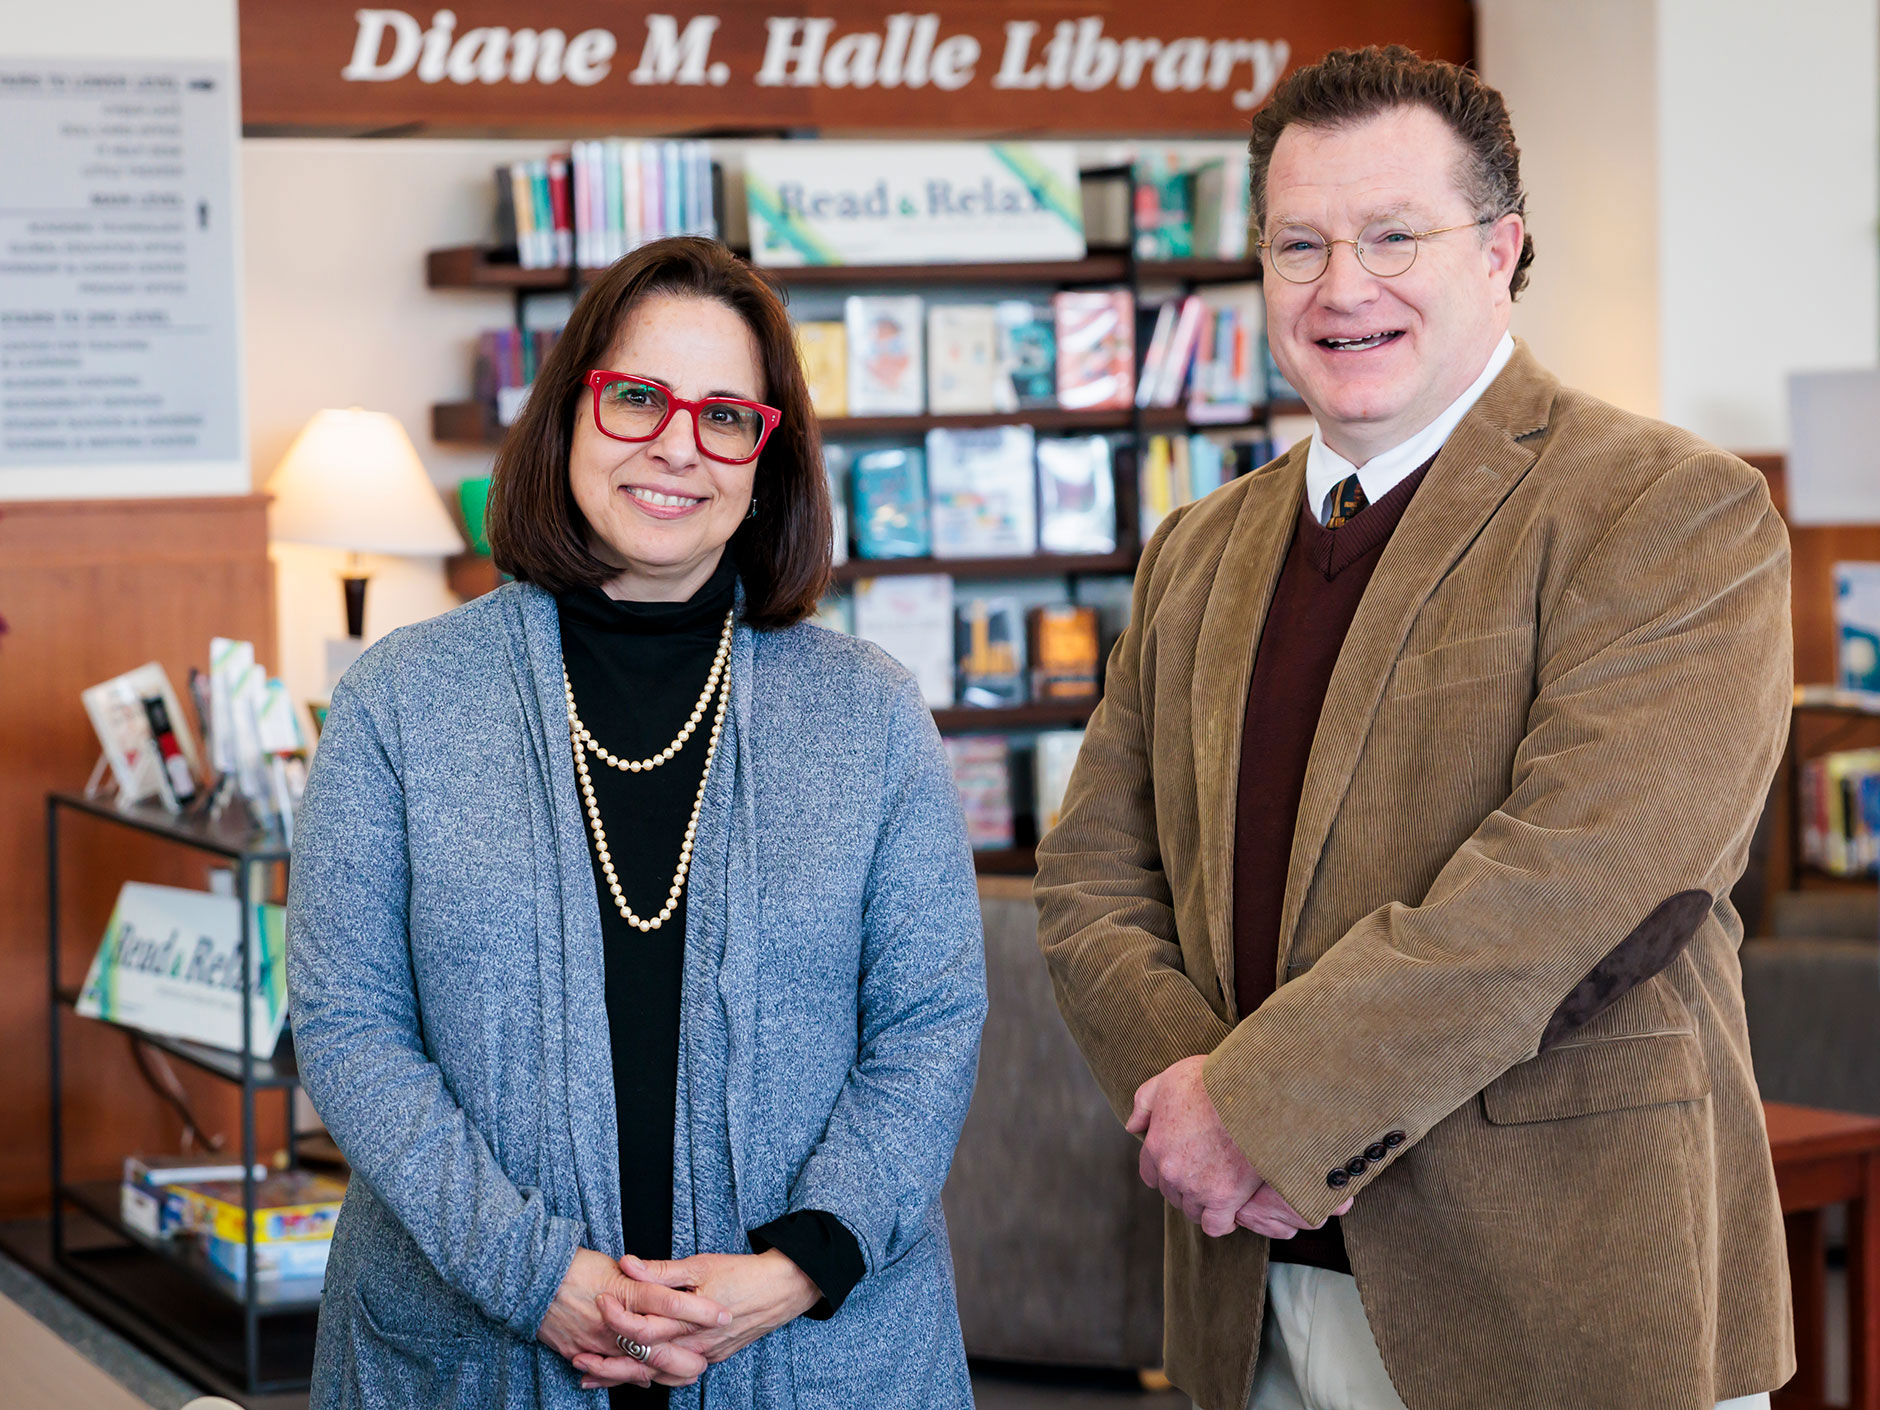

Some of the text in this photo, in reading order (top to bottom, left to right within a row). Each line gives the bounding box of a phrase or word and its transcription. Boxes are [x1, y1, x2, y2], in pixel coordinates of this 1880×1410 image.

[340, 8, 1291, 111] Diane M. Halle Library
[778, 177, 889, 220] Read
[925, 175, 1050, 218] Relax
[108, 923, 180, 976] Read
